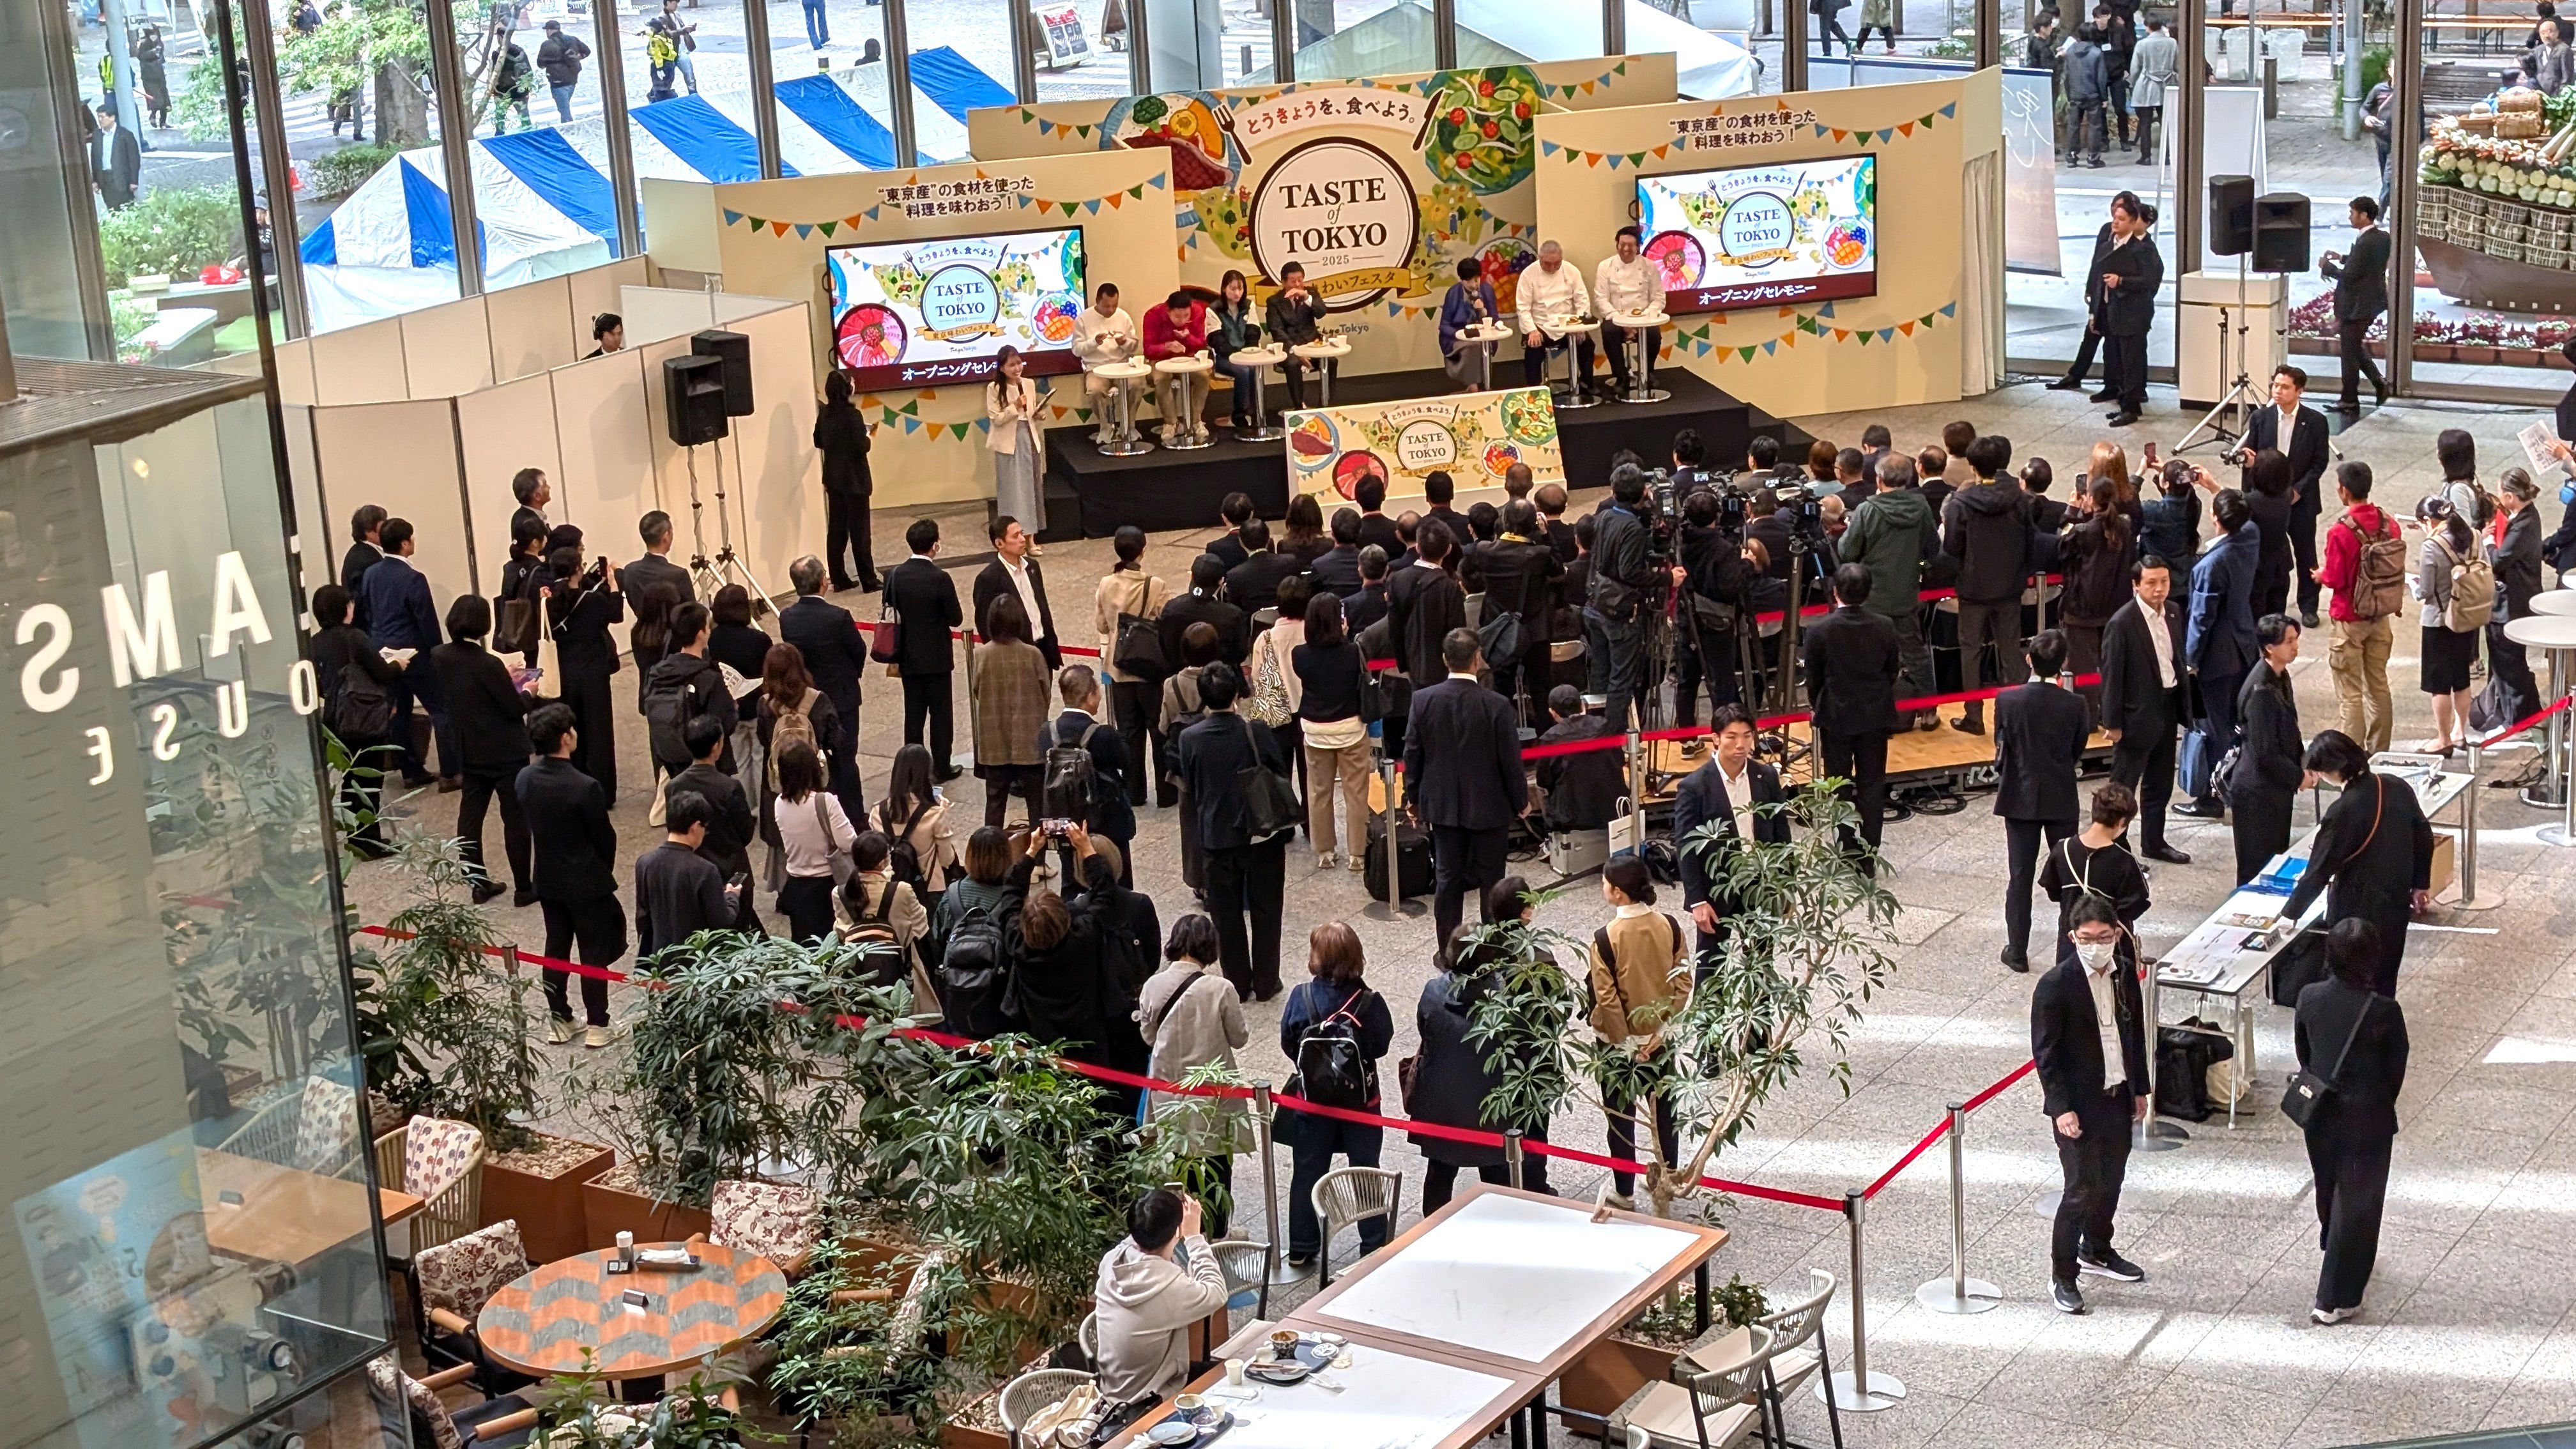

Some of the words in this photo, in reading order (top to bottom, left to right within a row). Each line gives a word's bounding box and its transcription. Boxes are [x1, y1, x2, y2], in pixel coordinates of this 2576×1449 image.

[1247, 96, 1416, 135] とうきょうを、食べよう。
[1669, 109, 1816, 134] “東京産”の食材を使った
[1694, 128, 1794, 150] 料理を味わおう！
[878, 176, 1034, 202] “東京産”の食材を使った
[1721, 174, 1795, 192] とうきょうを、食べよう。
[1279, 178, 1386, 209] TASTE
[906, 195, 1013, 218] 料理を味わおう！
[1327, 202, 1345, 225] of
[1733, 208, 1781, 224] TASTE
[1282, 222, 1387, 254] TOKYO
[1733, 227, 1781, 243] TOKYO
[918, 246, 997, 264] とうきょうを、食べよう。
[1322, 254, 1350, 266] 2025
[933, 282, 985, 297] TASTE
[1699, 284, 1817, 305] オープニングセレモニー
[935, 301, 986, 317] TOKYO
[1406, 433, 1444, 445] TASTE
[1408, 447, 1446, 459] TOKYO
